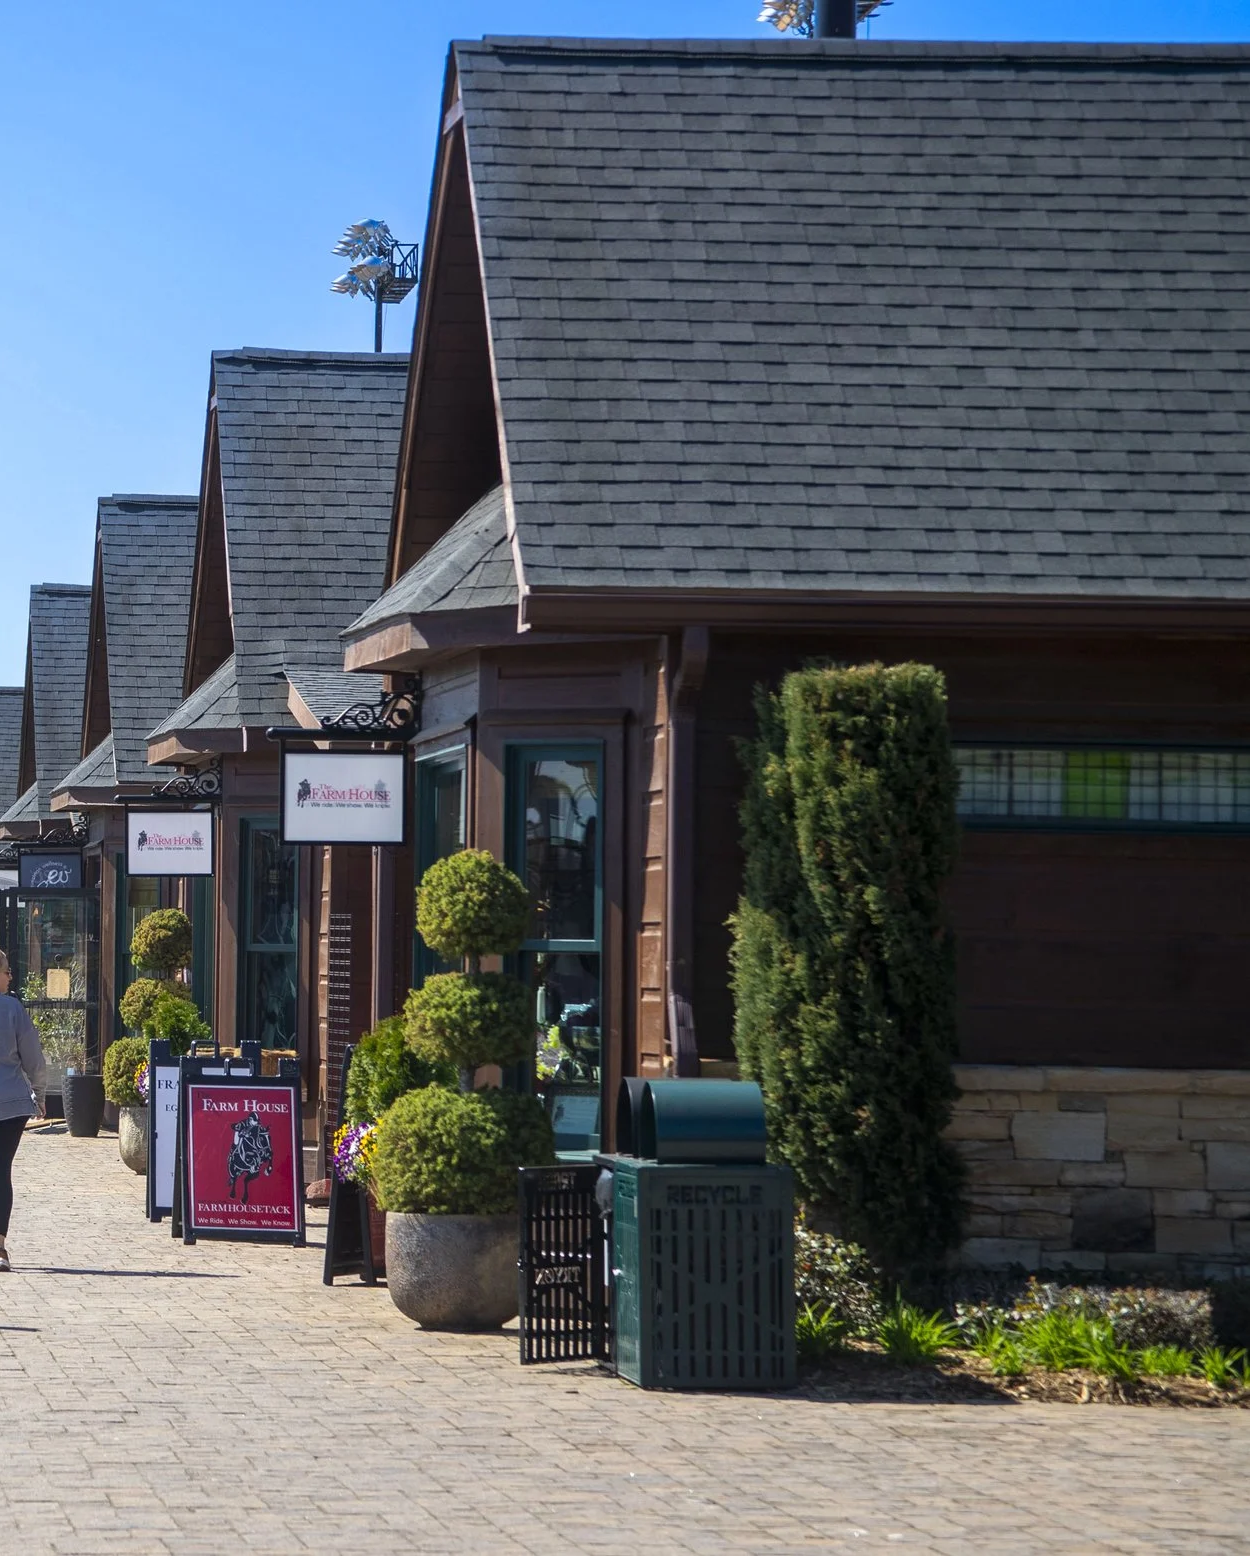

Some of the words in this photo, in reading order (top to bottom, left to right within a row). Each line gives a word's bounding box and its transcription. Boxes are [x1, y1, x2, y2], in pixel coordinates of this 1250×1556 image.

[312, 788, 346, 800] FARM
[202, 1098, 238, 1112] FARM
[243, 1099, 289, 1113] HOUSE
[666, 1184, 763, 1206] RECYCLE
[197, 1203, 291, 1215] FARMHOUSETACK
[209, 1217, 225, 1225] Ride.
[239, 1218, 258, 1226] Show.
[273, 1219, 292, 1227] Know.
